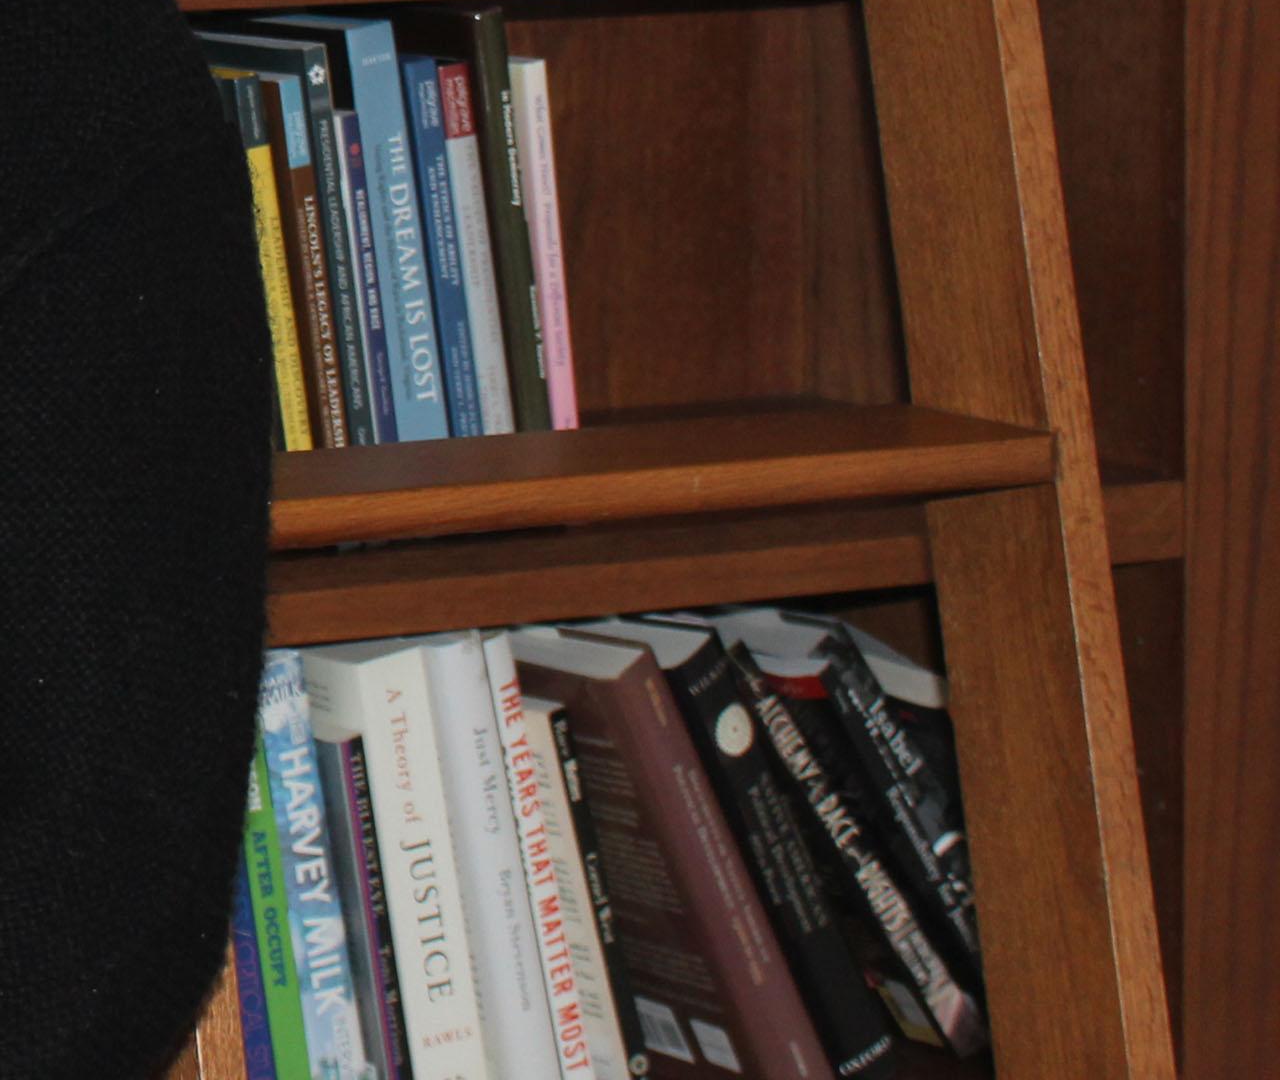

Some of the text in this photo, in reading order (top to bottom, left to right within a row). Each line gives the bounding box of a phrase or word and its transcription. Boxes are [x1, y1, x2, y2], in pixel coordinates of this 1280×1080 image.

[386, 133, 438, 403] THE DREAM IS LOST
[252, 831, 287, 987] AFTER OCCUPY
[279, 746, 346, 1016] HARVEY MILK
[386, 689, 454, 1002] A Theory of JUSTICE
[500, 676, 590, 1071] THE YEARS THAT MATTER MOST
[422, 1027, 473, 1048] RAWLS
